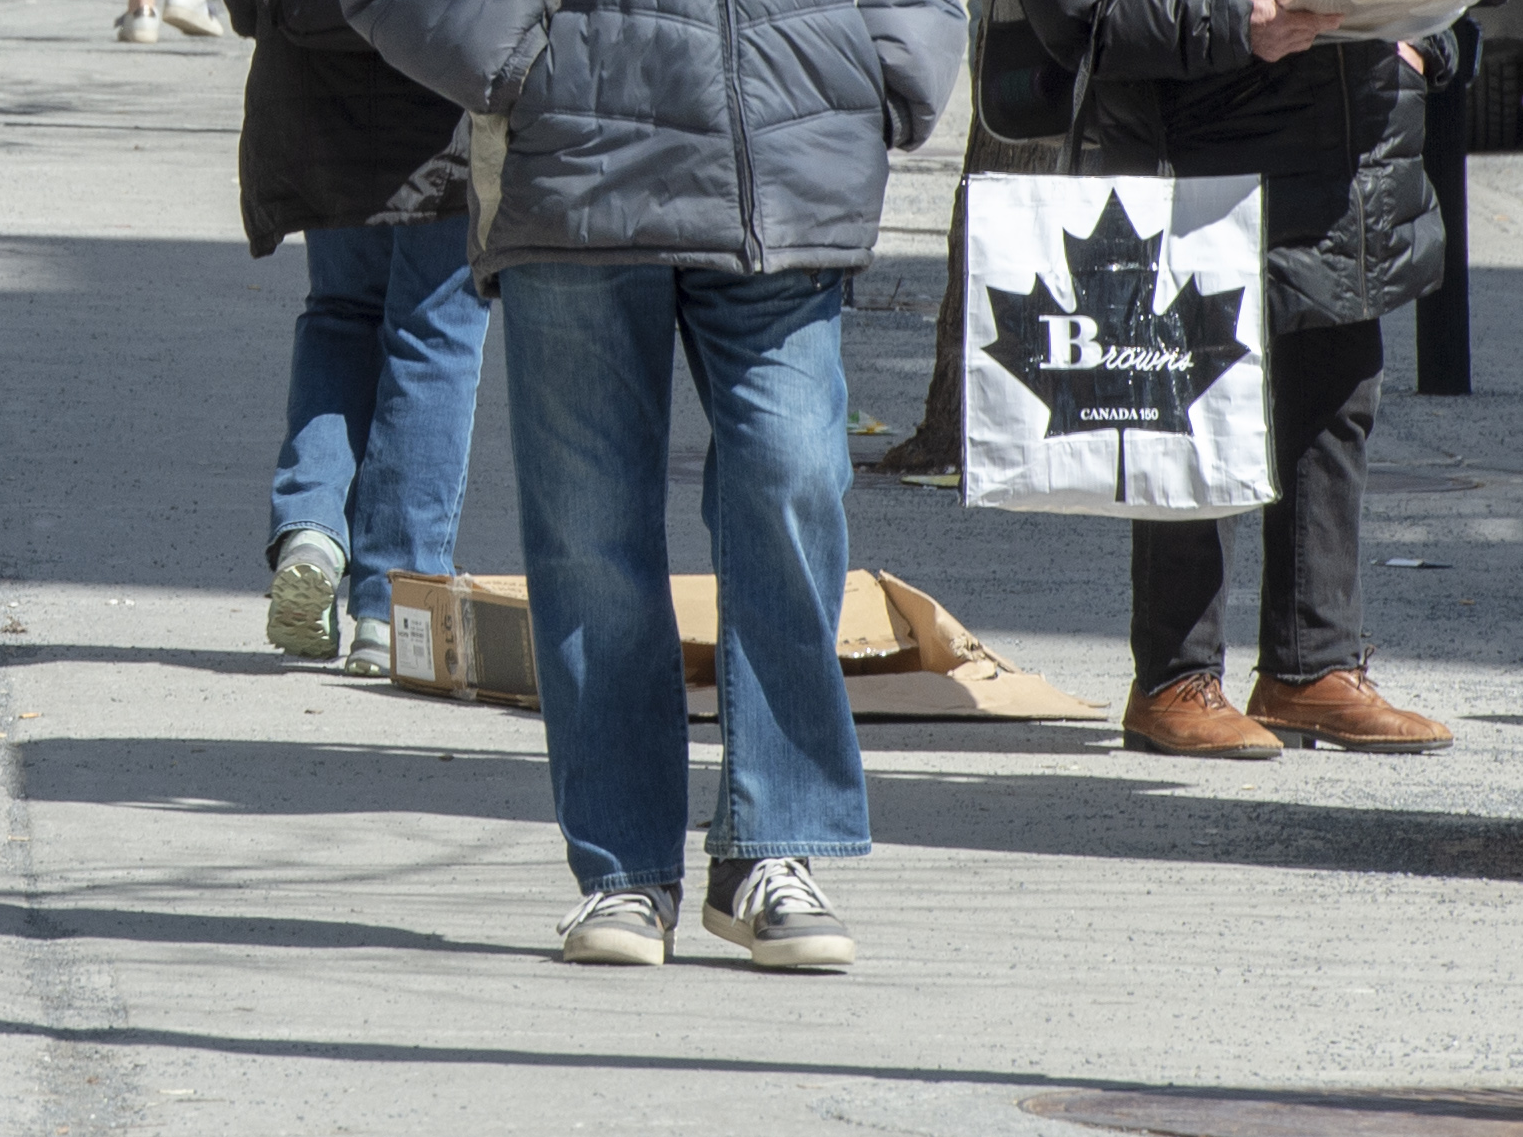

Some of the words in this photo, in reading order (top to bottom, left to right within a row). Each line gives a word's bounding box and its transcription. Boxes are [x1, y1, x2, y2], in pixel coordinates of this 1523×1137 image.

[1038, 314, 1195, 372] Browns
[1080, 407, 1140, 421] CANADA
[1139, 407, 1159, 421] 150
